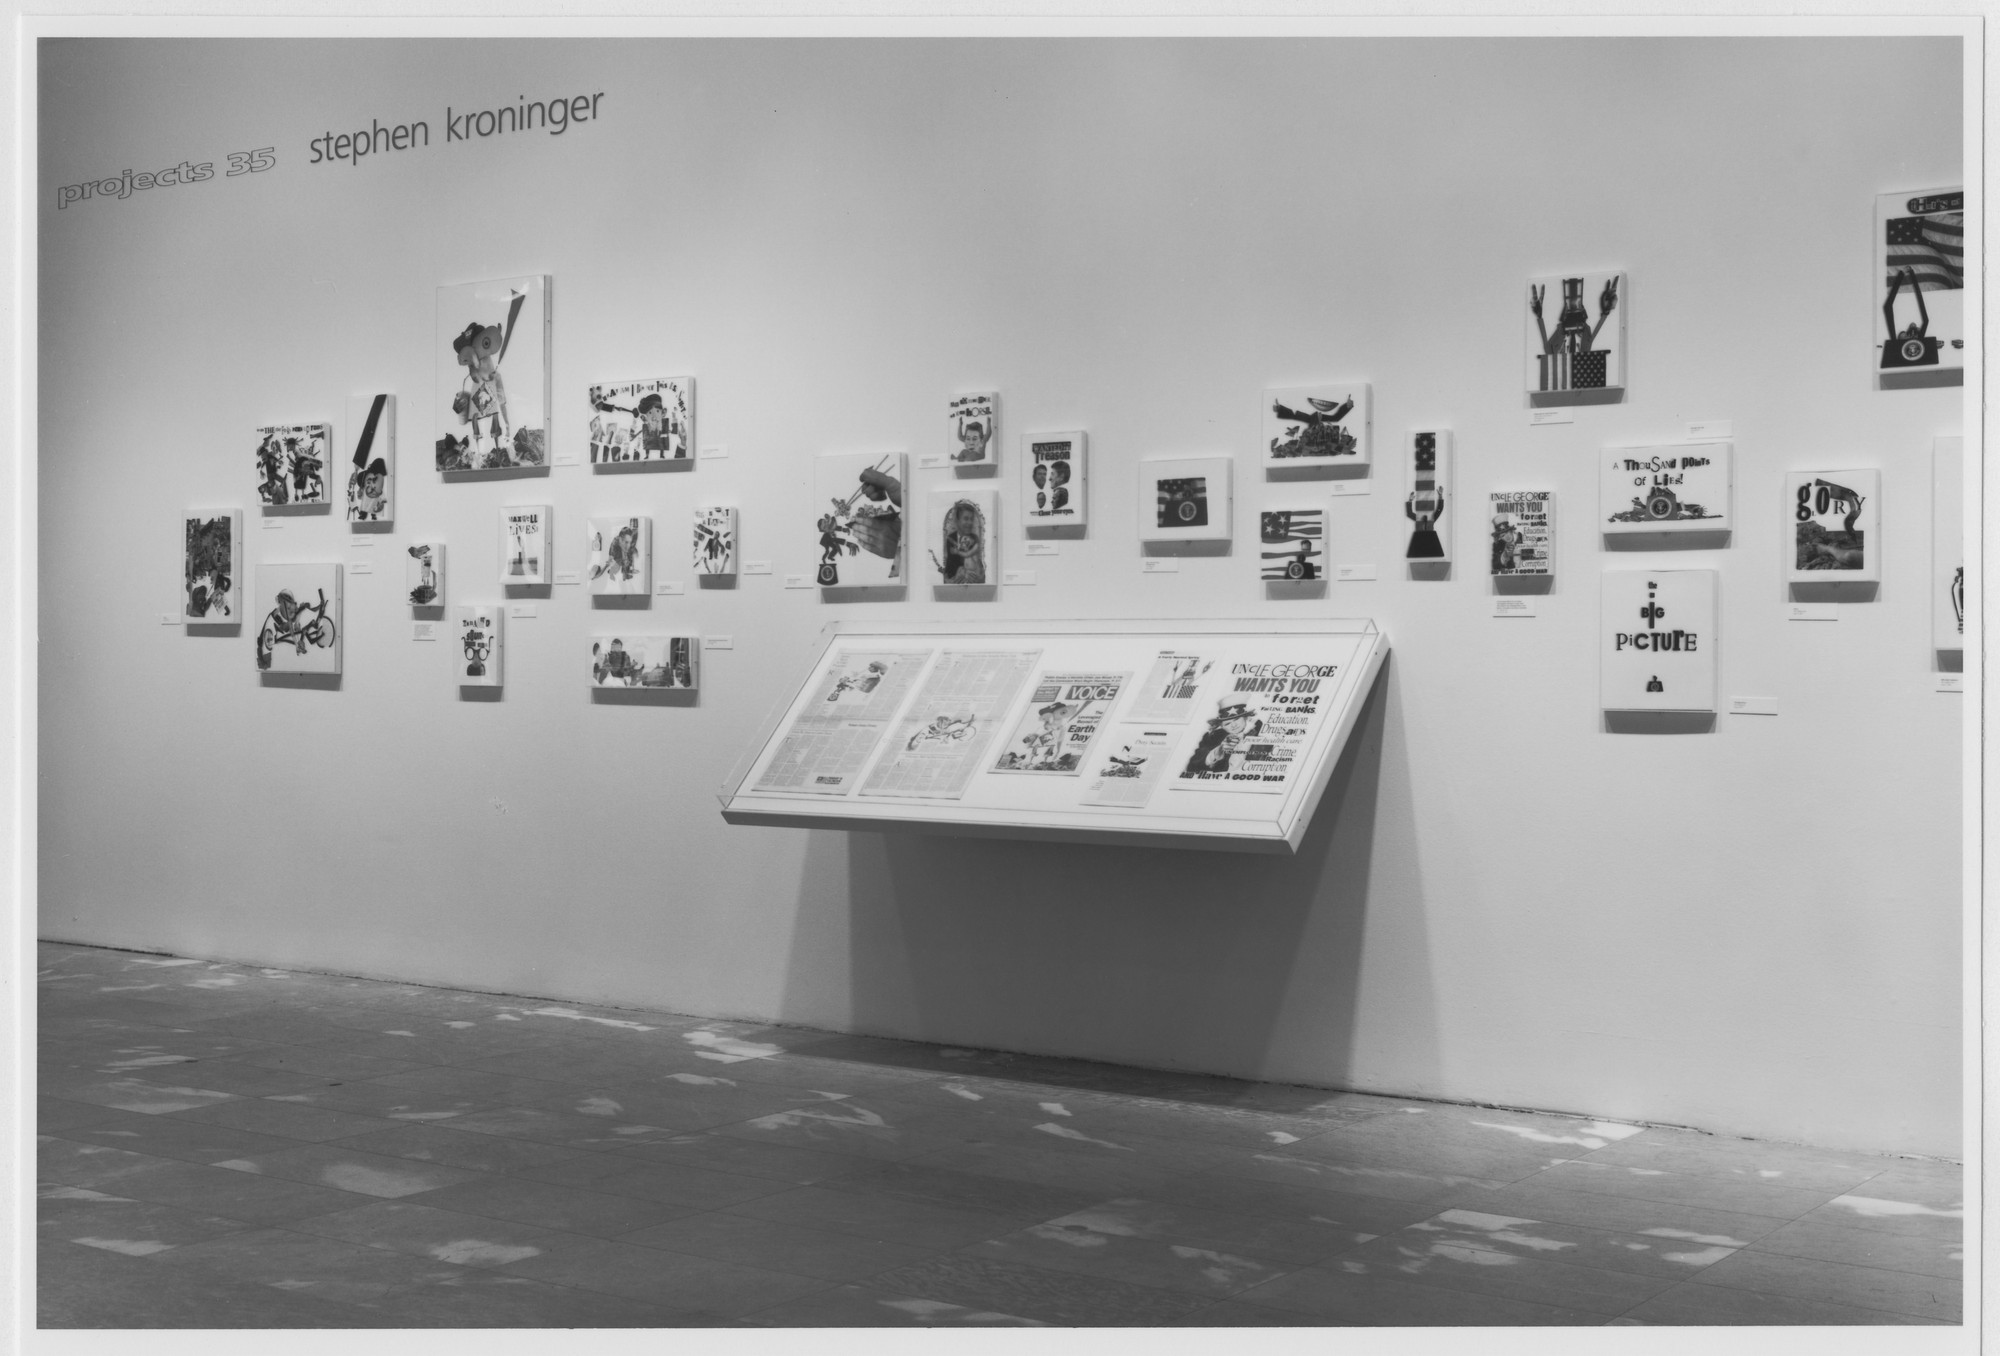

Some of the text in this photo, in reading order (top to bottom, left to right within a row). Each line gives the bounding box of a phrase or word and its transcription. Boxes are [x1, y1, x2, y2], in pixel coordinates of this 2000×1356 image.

[57, 90, 605, 209] projects 35 stephen kroninger
[1613, 462, 1619, 470] A
[1513, 492, 1550, 502] GEORGE
[1497, 501, 1543, 513] WANTS YOU
[1272, 664, 1338, 678] GEORGE
[1234, 677, 1321, 693] WANTS YOU
[1071, 686, 1119, 699] VOICE
[1272, 694, 1320, 704] forget
[1067, 724, 1096, 733] Earth
[1070, 733, 1091, 743] Day
